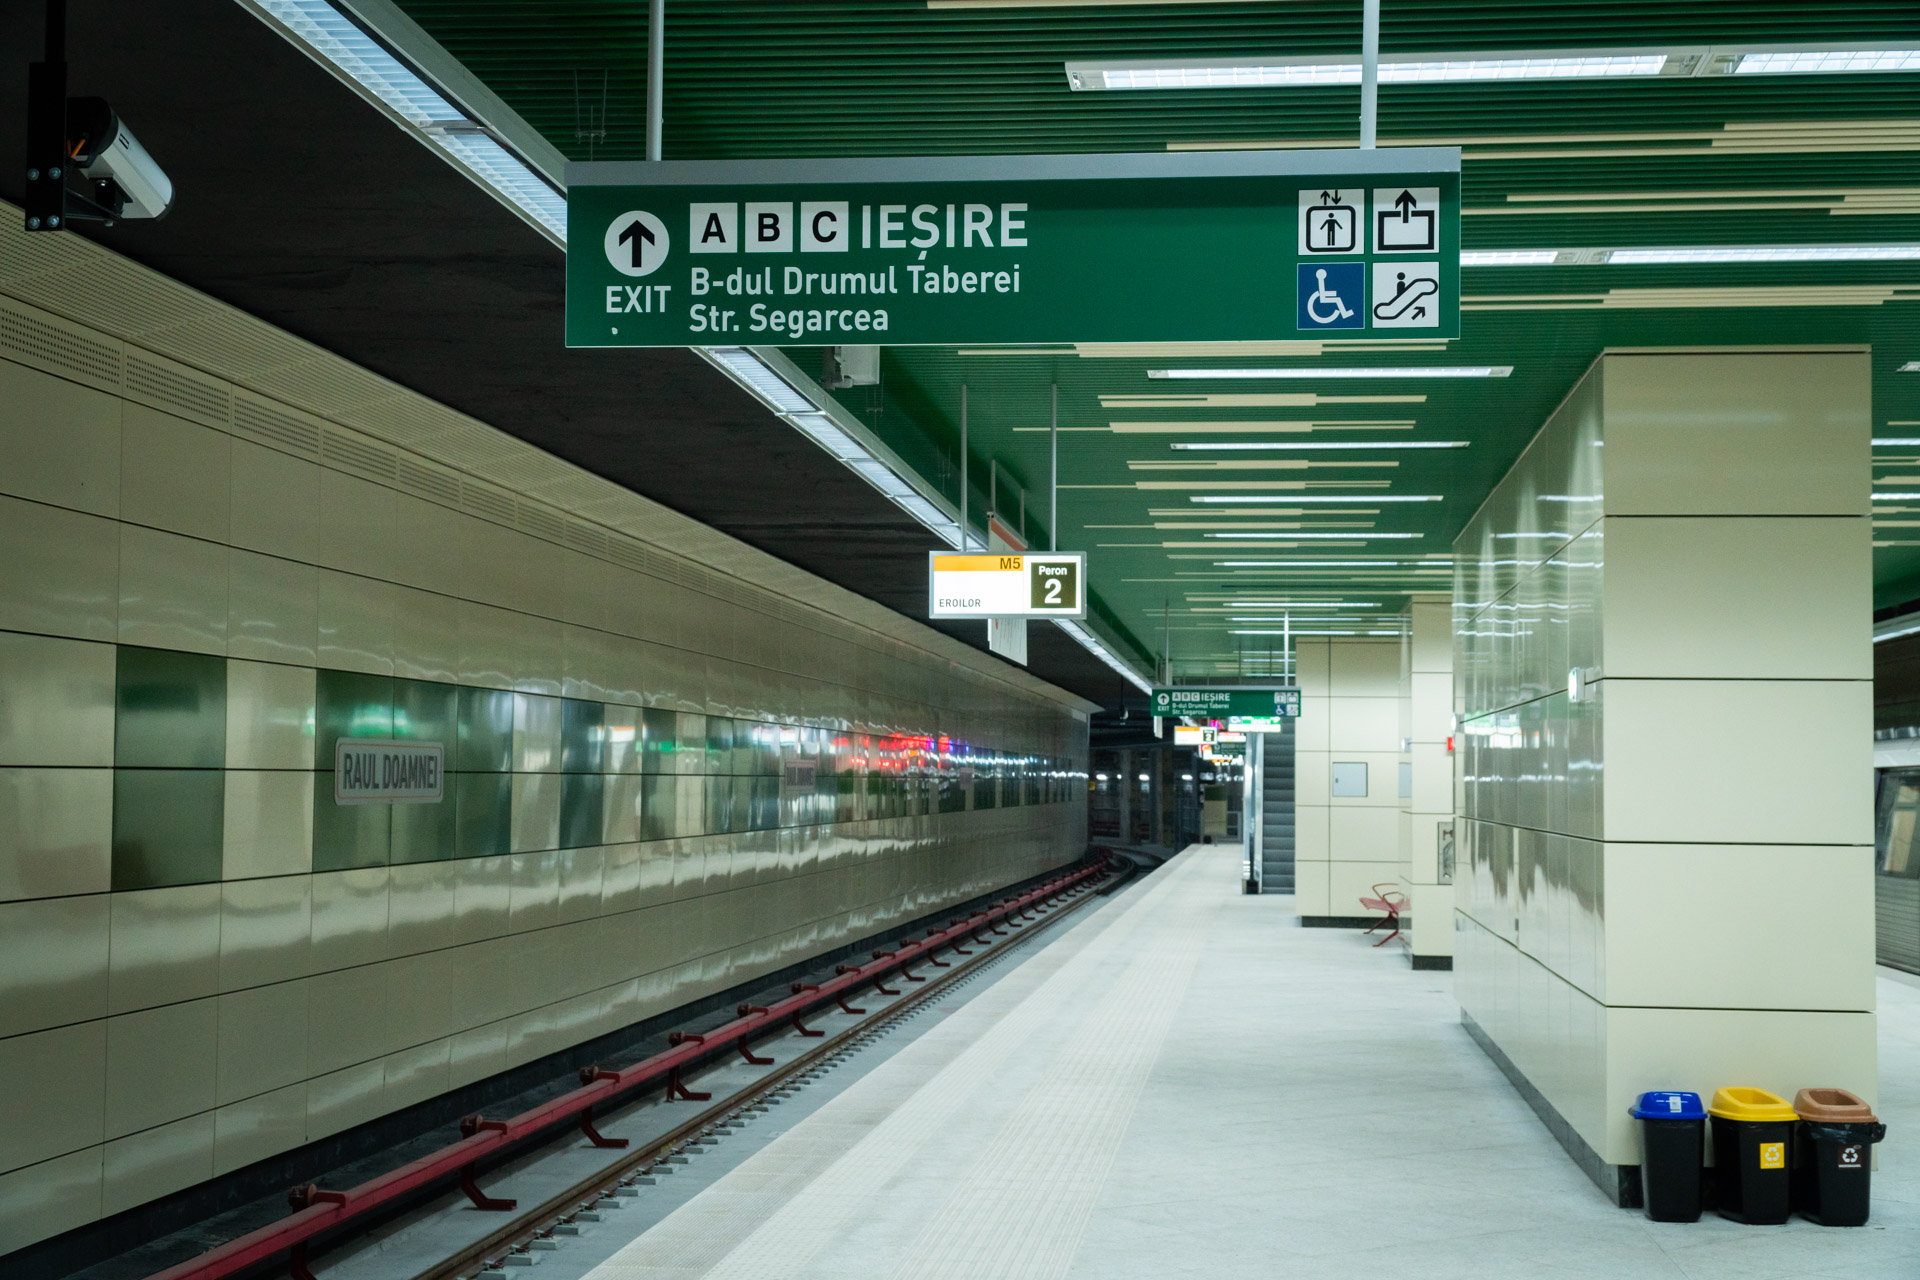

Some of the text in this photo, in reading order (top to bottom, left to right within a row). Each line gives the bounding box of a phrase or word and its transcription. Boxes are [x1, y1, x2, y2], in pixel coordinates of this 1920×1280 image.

[701, 203, 1029, 261] A B C IEȘIRE
[691, 264, 1021, 296] B-dul Drumul Taberei
[605, 285, 672, 313] EXIT
[689, 303, 889, 339] Str. Segarcea
[1000, 557, 1021, 570] M5
[1038, 565, 1068, 576] Peron
[939, 598, 981, 608] EROILOR
[1044, 578, 1062, 604] 2
[343, 753, 438, 789] RAUL DOAMNEI
